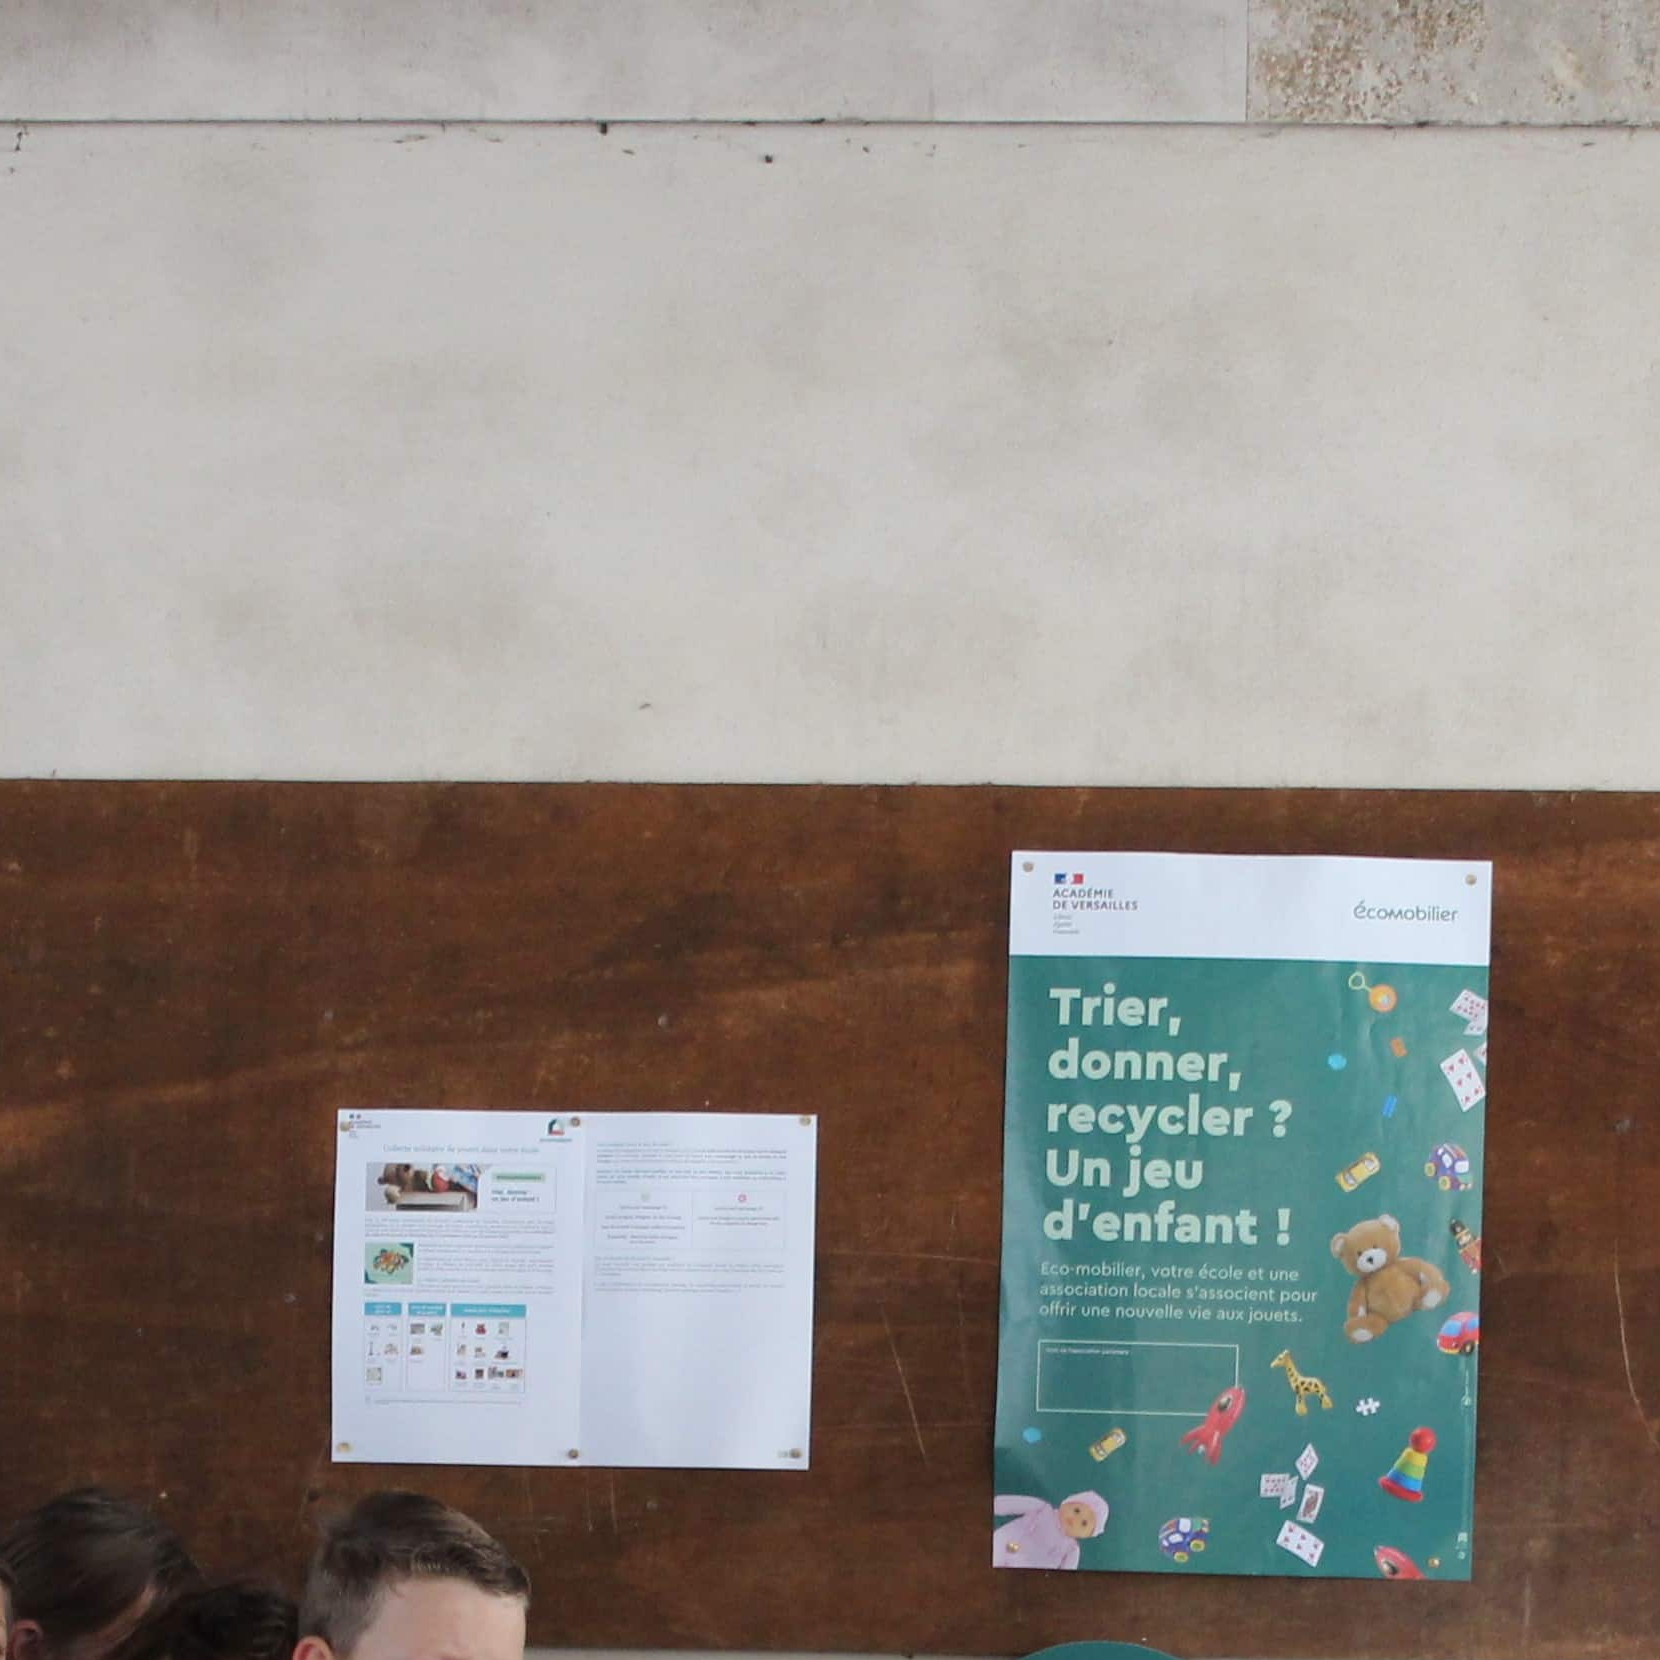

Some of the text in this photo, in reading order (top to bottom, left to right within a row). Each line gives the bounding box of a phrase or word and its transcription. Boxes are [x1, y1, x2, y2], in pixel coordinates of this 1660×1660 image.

[1052, 886, 1114, 899] ACADÉMIE
[1052, 900, 1139, 911] DE VERSAILLES
[1049, 983, 1182, 1036] Trier,
[1048, 1037, 1241, 1092] donner,
[1047, 1093, 1292, 1143] recycler ?
[1046, 1144, 1204, 1198] Un jeu
[1043, 1200, 1258, 1246] d'enfant
[1151, 1266, 1193, 1280] votre
[1198, 1264, 1243, 1281] école
[1247, 1268, 1264, 1281] et
[1269, 1270, 1299, 1281] une
[1039, 1282, 1318, 1305] association locale s'associent pour
[1039, 1302, 1302, 1324] offrir une nouvelle vie aux jouets.
